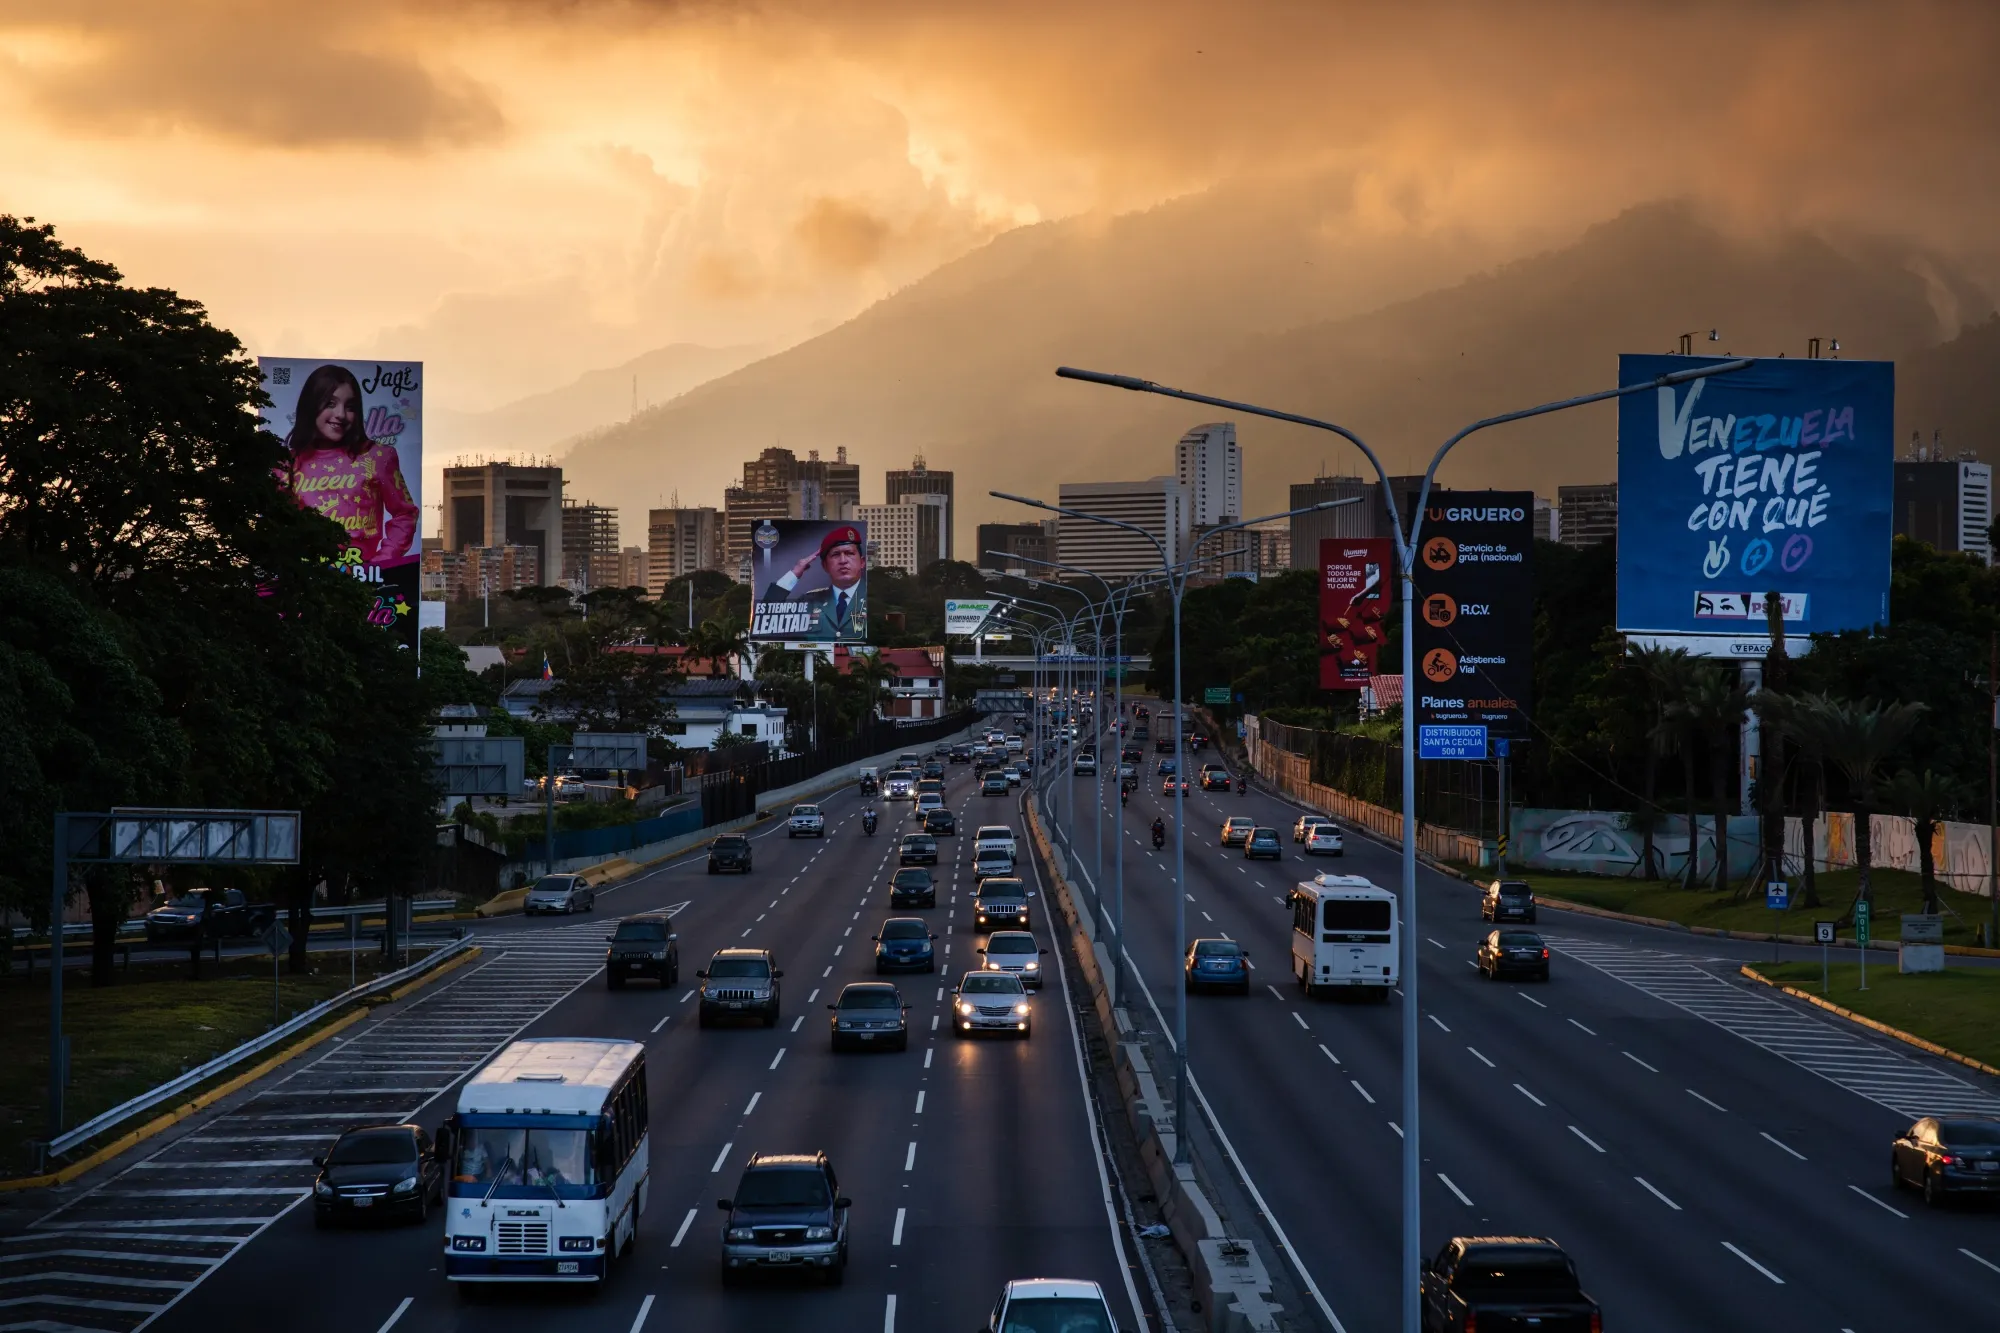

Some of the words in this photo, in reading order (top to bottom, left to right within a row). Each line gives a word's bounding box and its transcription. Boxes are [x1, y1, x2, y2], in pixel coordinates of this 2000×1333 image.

[1658, 377, 1855, 460] VENEZUELA
[1694, 451, 1822, 499] TIENE
[1687, 497, 1757, 532] CON
[1762, 484, 1831, 533] QUÉ
[1343, 548, 1368, 559] Yummy
[1458, 544, 1492, 552] Servicio
[1495, 544, 1507, 552] de
[1458, 552, 1479, 563] grúa
[1481, 552, 1523, 563] (nacional)
[755, 603, 767, 613] ES
[767, 602, 798, 613] TIEMPO
[798, 602, 808, 612] DE
[1461, 605, 1490, 616] R.C.V.
[1751, 599, 1792, 615] PSV
[1459, 655, 1506, 664] Asistencia
[1459, 665, 1475, 674] Vial
[1421, 697, 1465, 709] Planes
[1467, 697, 1517, 709] anuales
[1435, 713, 1468, 721] tugruero.io
[1482, 713, 1508, 721] tugruero
[1425, 729, 1482, 737] DISTRIBUIDOR
[1423, 738, 1450, 746] SANTA
[1452, 738, 1483, 746] CECILIA
[1441, 747, 1456, 756] 500
[1457, 747, 1465, 755] M
[1822, 929, 1829, 939] 9
